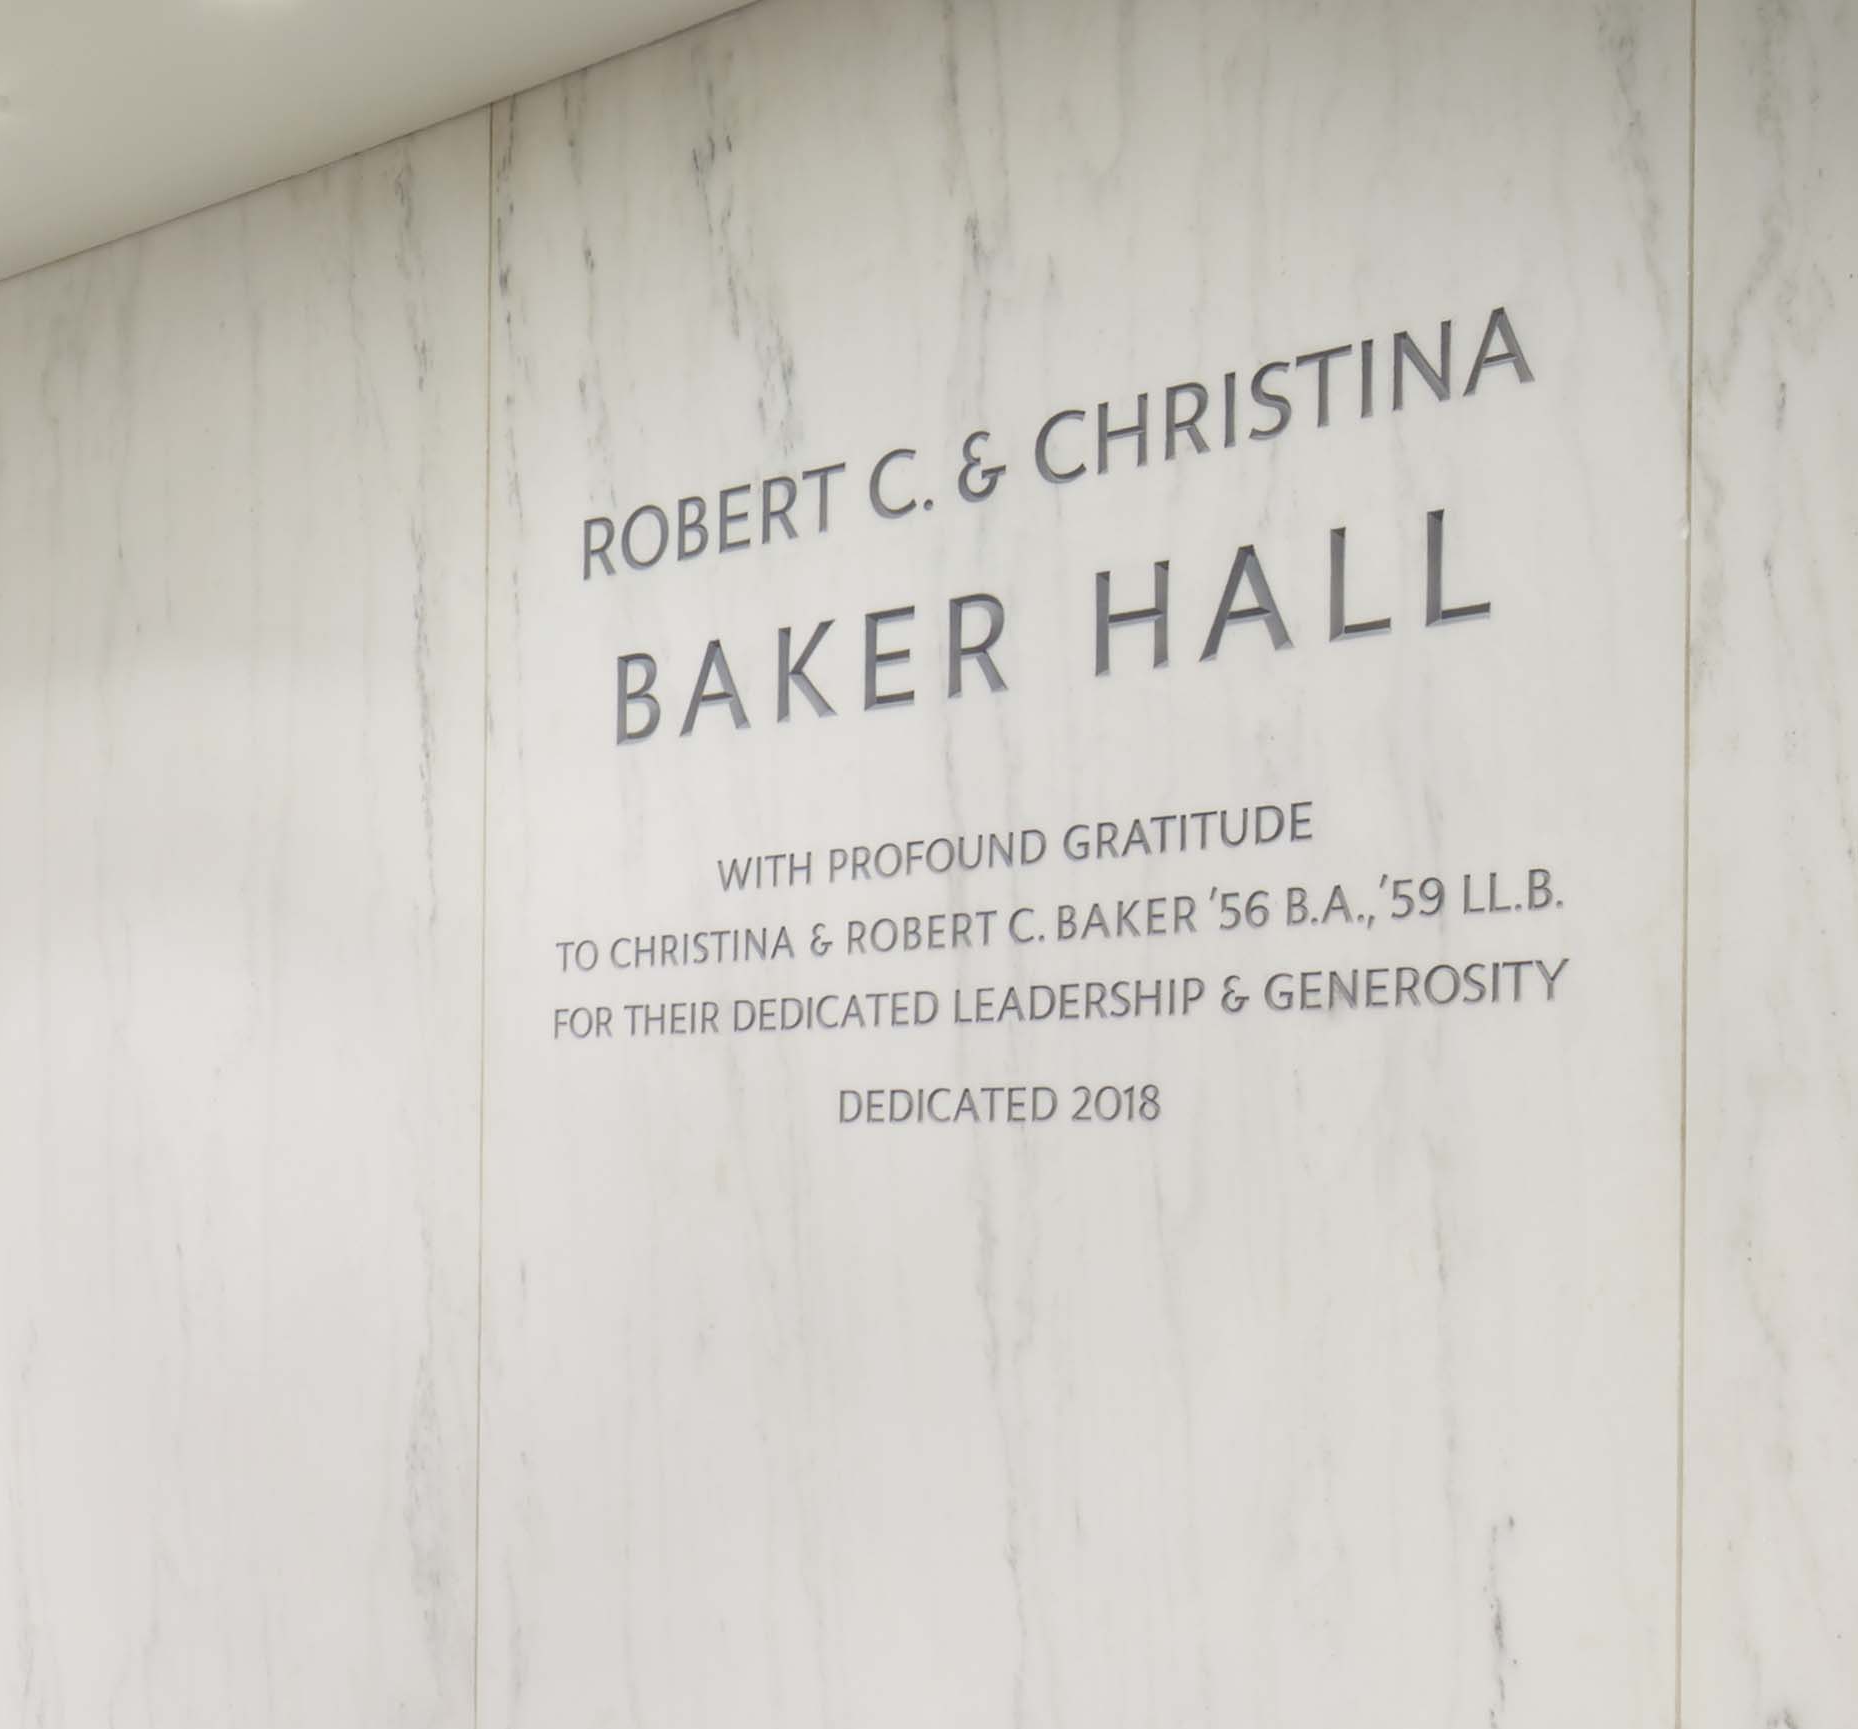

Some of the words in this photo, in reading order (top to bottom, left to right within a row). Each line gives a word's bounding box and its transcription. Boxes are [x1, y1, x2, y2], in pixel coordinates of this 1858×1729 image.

[583, 461, 847, 581] ROBERT
[868, 448, 934, 520] C.
[957, 430, 1007, 503] &
[1034, 306, 1535, 485] CHRISTINA
[616, 592, 1009, 746] BAKER
[1094, 507, 1492, 678] HALL
[717, 851, 812, 892] WITH
[829, 828, 1047, 883] PROFOUND
[1062, 800, 1313, 862] GRATITUDE
[555, 939, 599, 972] TO
[610, 925, 795, 969] CHRISTINA
[810, 922, 834, 957] &
[847, 909, 998, 955] ROBERT
[1008, 907, 1045, 944] C.
[1057, 895, 1197, 942] BAKER
[1462, 868, 1564, 915] LL.B.
[554, 1006, 613, 1039] FOR
[623, 1001, 719, 1036] THEIR
[733, 990, 939, 1033] DEDICATED
[954, 977, 1206, 1024] LEADERSHIP
[1220, 974, 1251, 1014] &
[1263, 957, 1570, 1012] GENEROSITY
[839, 1086, 1058, 1124] DEDICATED
[1071, 1083, 1161, 1122] 2018
